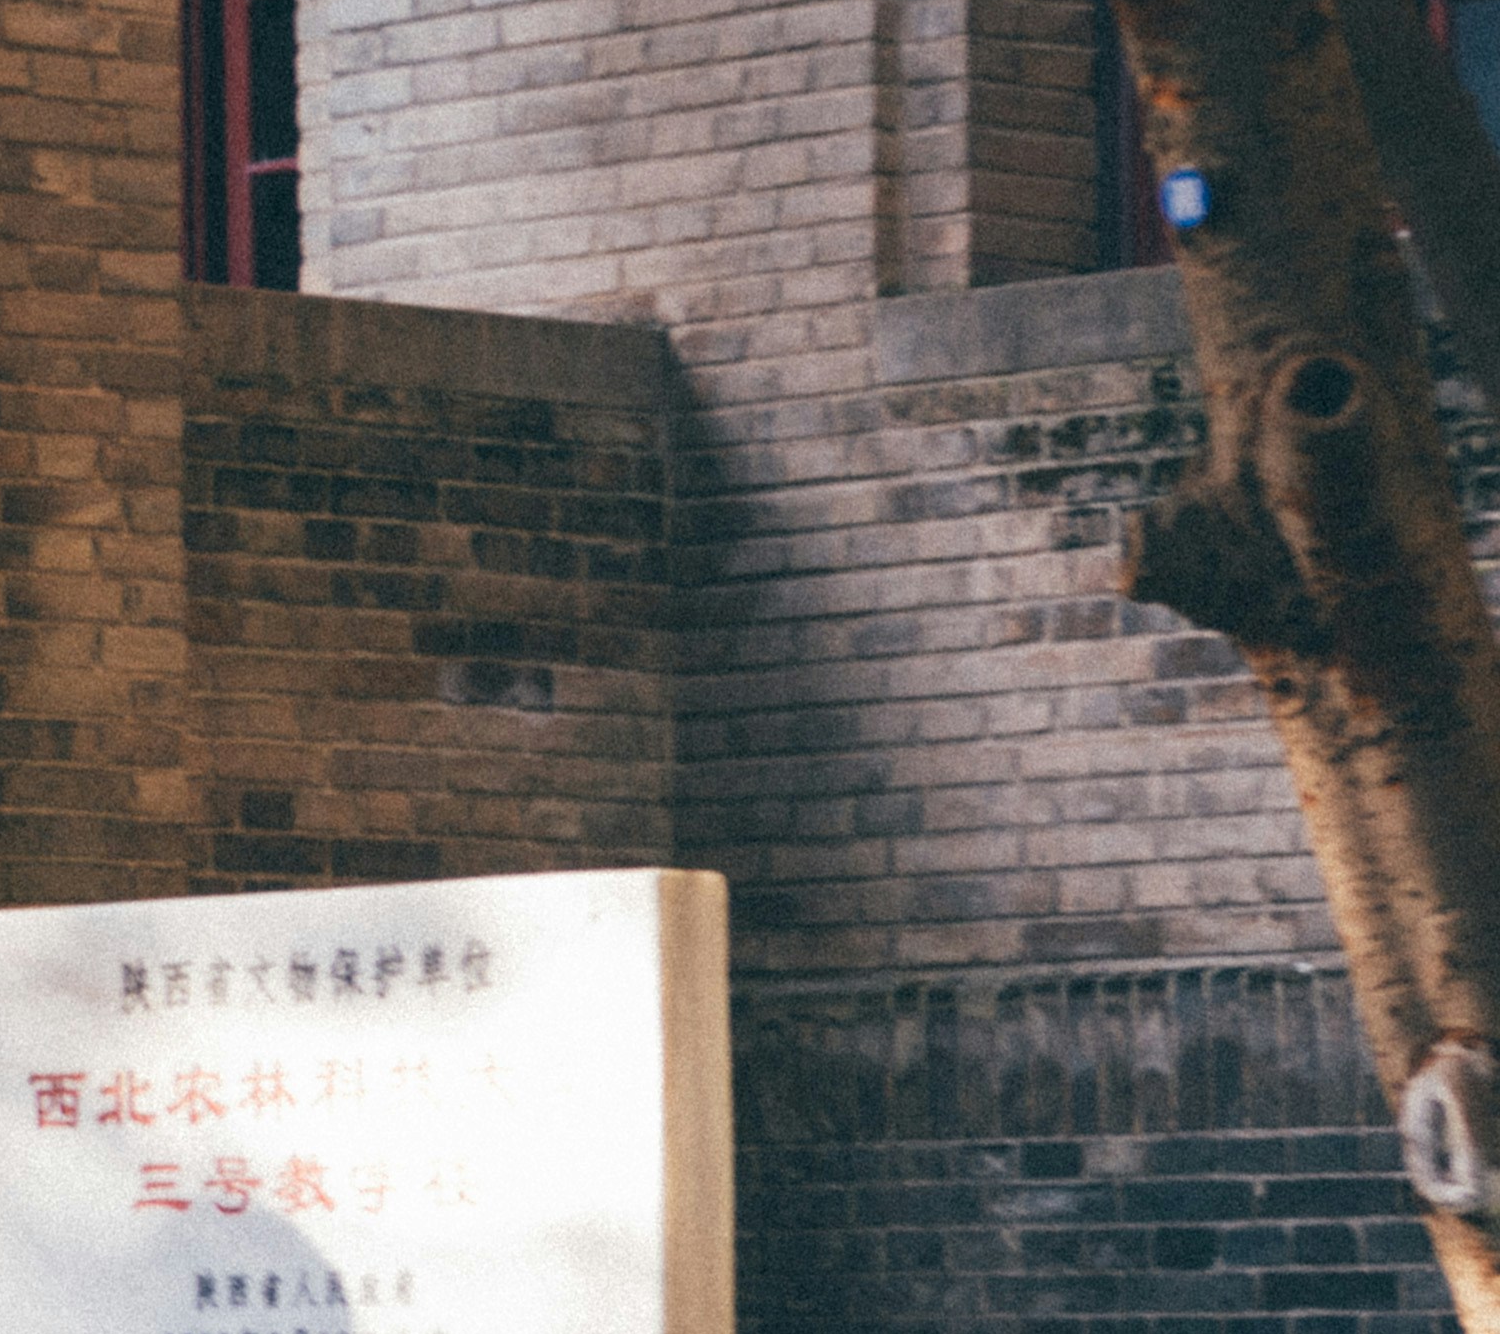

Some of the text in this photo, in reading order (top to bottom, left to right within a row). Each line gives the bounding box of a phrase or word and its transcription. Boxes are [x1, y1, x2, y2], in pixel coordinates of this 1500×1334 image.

[119, 938, 493, 1014] 陕西省文物保护单位
[28, 1052, 560, 1129] 西北农林科技大
